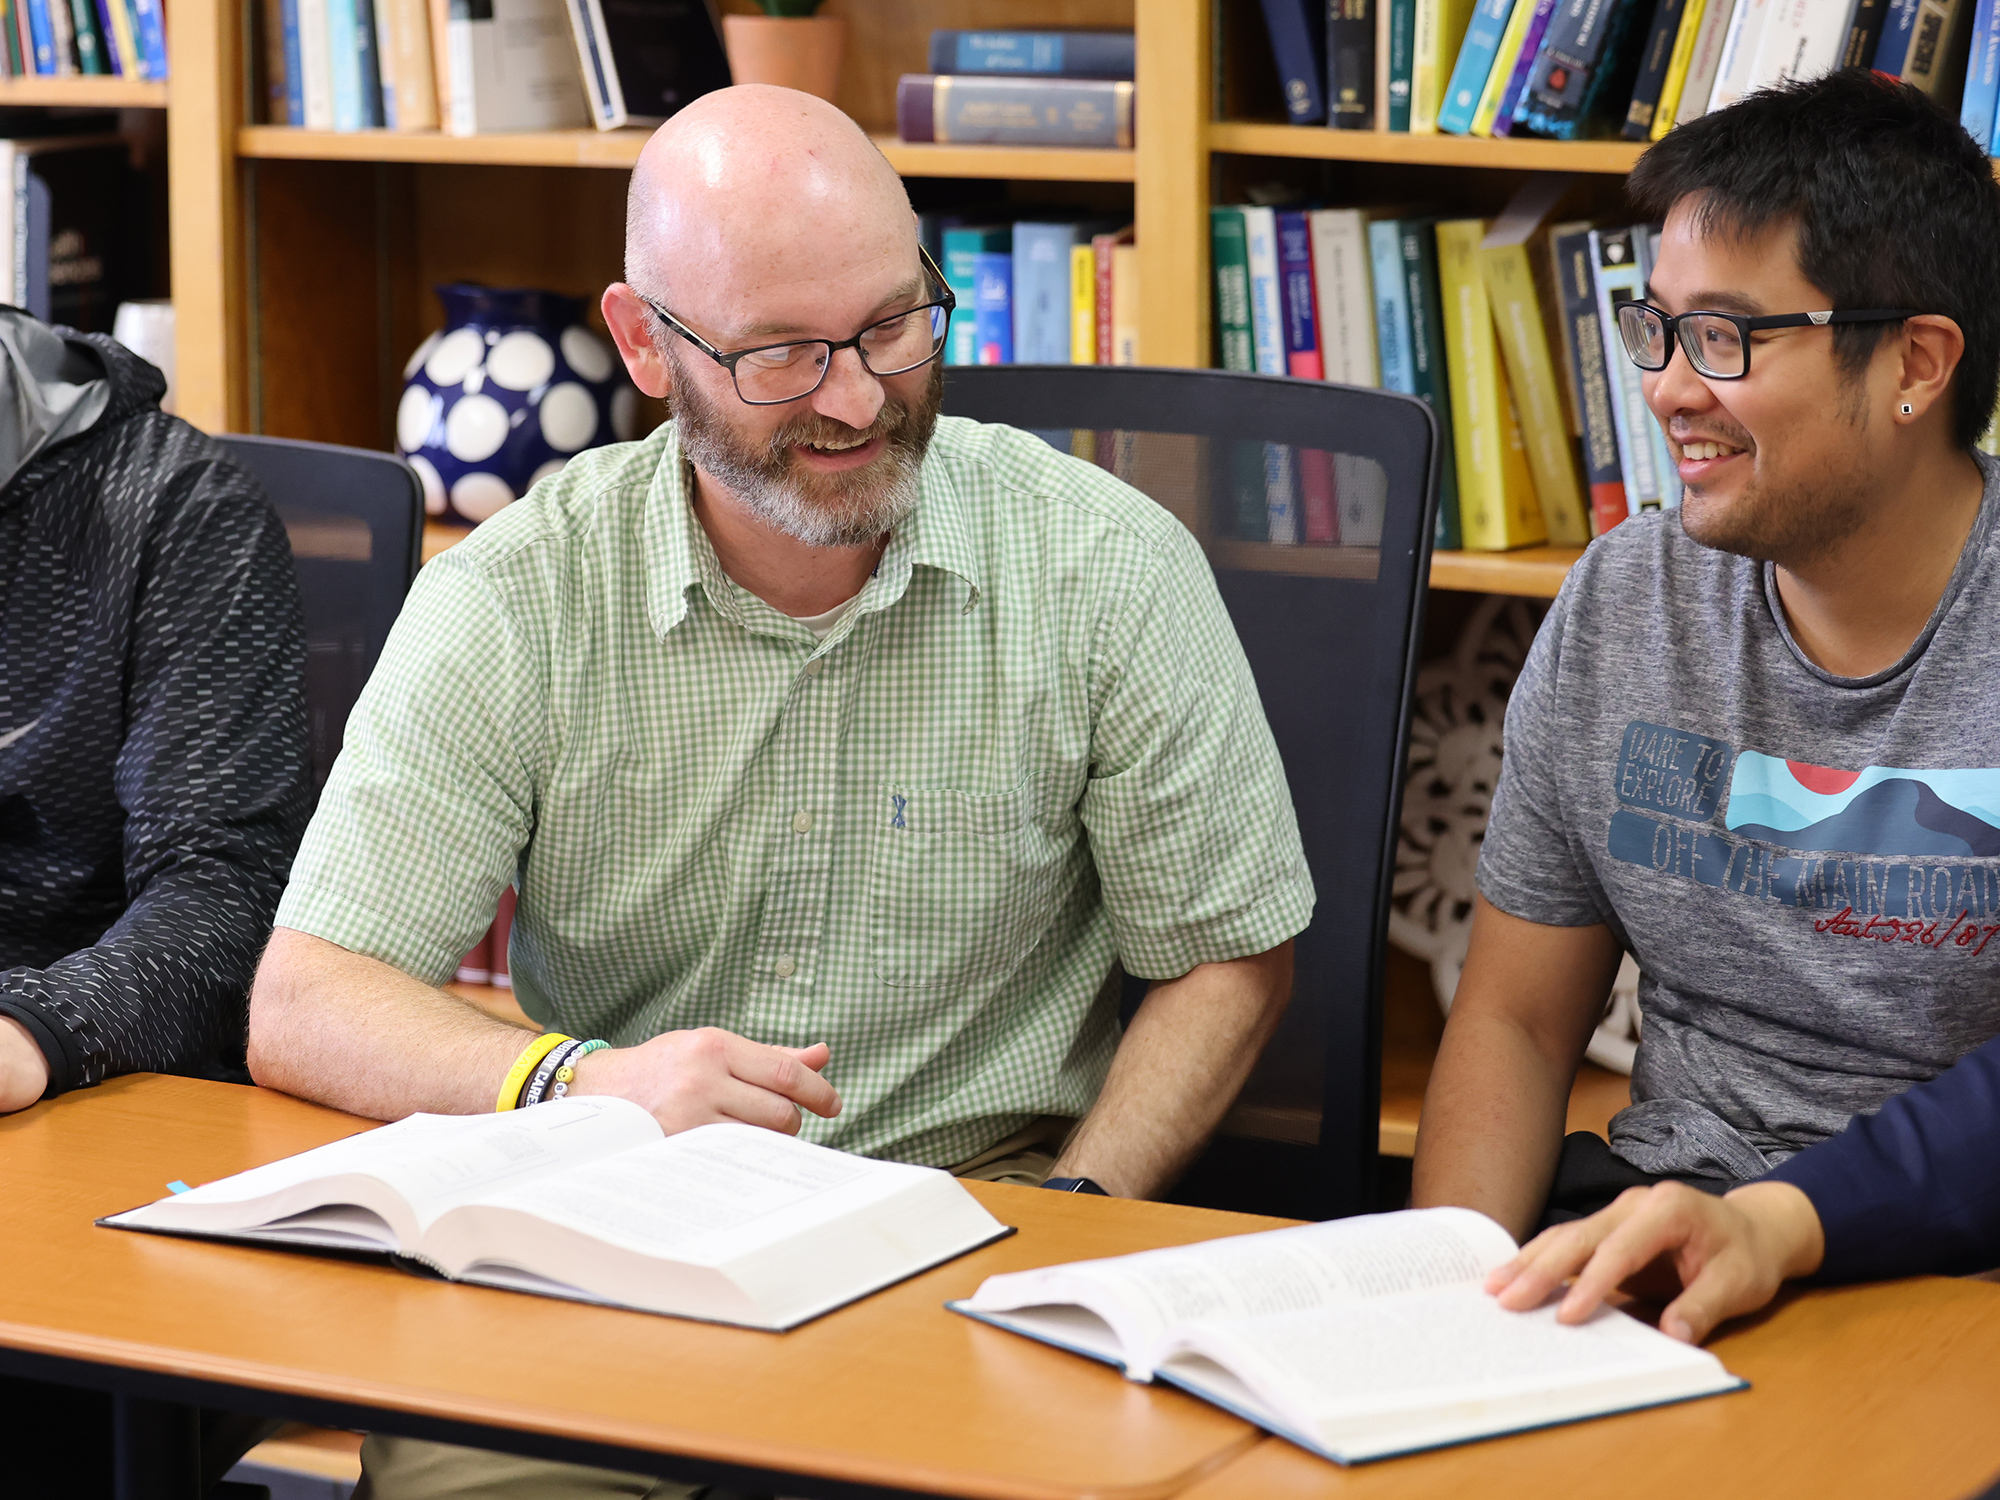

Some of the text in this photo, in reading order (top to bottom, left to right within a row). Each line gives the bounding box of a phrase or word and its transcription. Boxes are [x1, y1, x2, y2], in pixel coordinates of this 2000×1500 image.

[1628, 727, 1725, 782] DARE TO
[1620, 762, 1714, 815] EXPLORE
[1652, 822, 2000, 920] OFF THE MAIN ROAD
